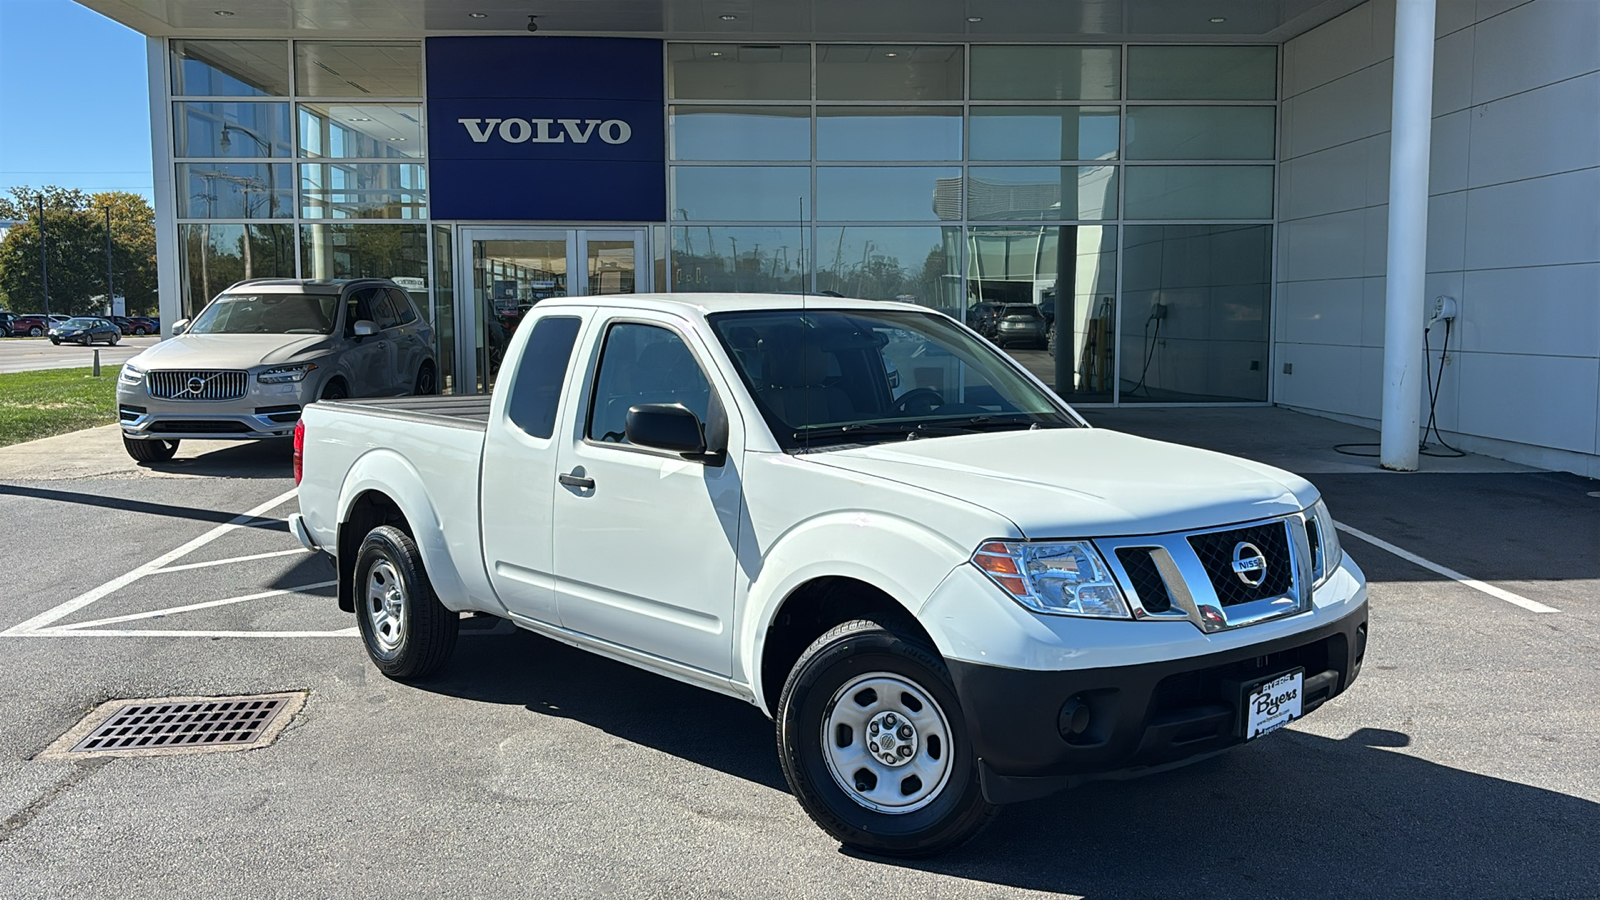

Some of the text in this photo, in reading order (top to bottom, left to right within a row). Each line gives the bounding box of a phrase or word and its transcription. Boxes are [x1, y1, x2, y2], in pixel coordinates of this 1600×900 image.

[458, 118, 631, 144] VOLVO
[1239, 558, 1264, 570] NISS
[1251, 688, 1297, 716] Byers
